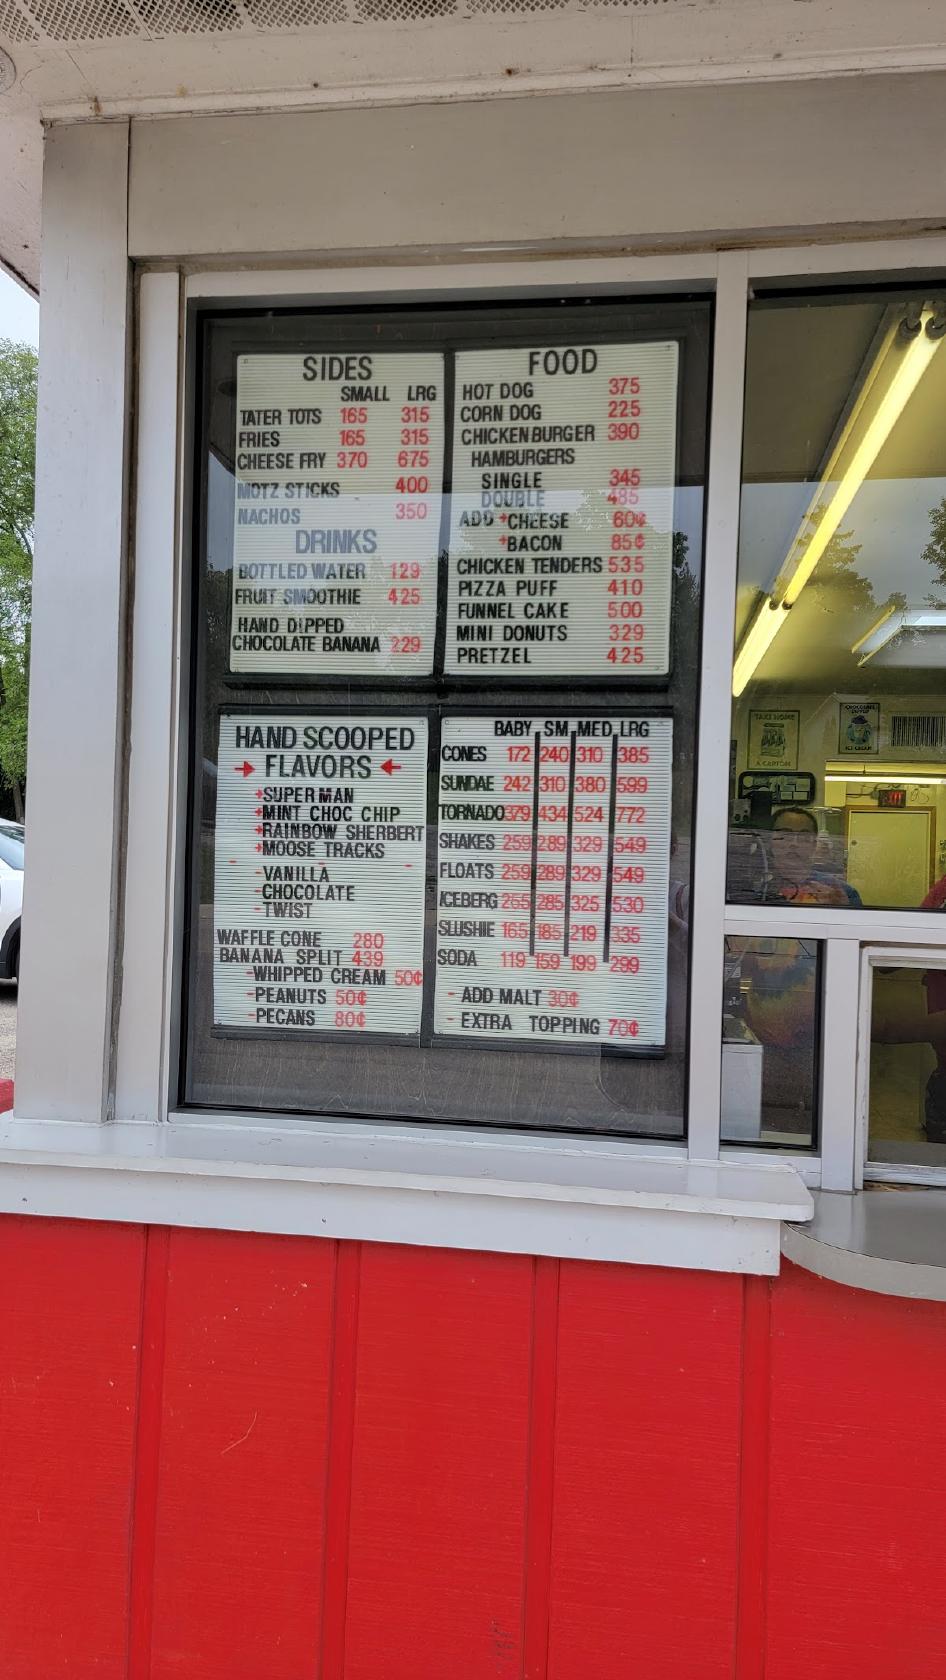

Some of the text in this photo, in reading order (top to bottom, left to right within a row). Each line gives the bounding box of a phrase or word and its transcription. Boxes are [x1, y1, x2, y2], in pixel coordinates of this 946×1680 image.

[302, 356, 373, 381] SIDES
[529, 349, 598, 375] FOOD
[340, 385, 436, 402] SMALL LRG
[463, 378, 640, 400] HOT DOG 375
[240, 407, 429, 426] TATER TOTS 165 315
[461, 400, 641, 422] CORN DOG 225
[239, 429, 429, 448] FRIES 165 315
[608, 423, 640, 440] 390
[237, 451, 429, 470] CHEESE FRY 370 675
[471, 449, 575, 467] HAMBURGERS
[237, 477, 428, 499] MOTZ STICKS 400
[482, 469, 641, 489] SINGLE 345
[481, 488, 639, 507] DOUBLE 485
[238, 503, 427, 524] NACHOS 350
[459, 511, 494, 526] ADD
[508, 513, 569, 529] CHEESE
[295, 530, 377, 554] DRINKS
[507, 535, 562, 552] BACON
[239, 562, 420, 579] BOTTLED WATER 129
[457, 557, 644, 574] CHICKEN TENDERS 535
[235, 588, 420, 605] FRUIT SMOOTHIE 425
[458, 579, 643, 597] PIZZA PUFF 410
[458, 602, 642, 620] FUNNEL CAKE 500
[238, 617, 344, 634] HAND DIPPED
[457, 624, 644, 642] MINI DONUTS 329
[232, 635, 421, 653] CHOCOLATE BANANA 229
[457, 646, 644, 664] PRETZEL 425
[235, 726, 415, 750] HAND SCOOPED
[494, 721, 649, 737] BABY SM MED LRG
[442, 745, 649, 763] CONES 172 240 310 385
[265, 755, 372, 779] FLAVORS
[441, 776, 648, 793] SUNDAE 242 310 380 599
[262, 806, 401, 823] MINT CHOC CHIP
[439, 805, 645, 823] TORNADO 379 434 524 772
[262, 824, 424, 841] RAINBOW SHERBERT
[262, 841, 384, 858] MOOSE TRACKS
[439, 834, 646, 853] SHAKES 259 289 329 549
[263, 866, 330, 882] VANILLA
[440, 863, 644, 883] FLOATS 259 289 329 549
[262, 884, 355, 901] CHOCOLATE
[263, 902, 312, 918] TWIST
[440, 892, 497, 909] ICEBERG
[536, 893, 564, 910] 285
[571, 894, 599, 911] 325
[612, 896, 644, 912] 530
[218, 929, 384, 949] WAFFLE CONE 280
[438, 921, 640, 943] SLUSHIE 165 185 219 335
[219, 948, 384, 967] BANANA SPLIT 439
[438, 950, 640, 973] SODA 119 159 199 299
[253, 967, 323, 983] WHIPPED
[331, 969, 386, 985] CREAM
[255, 988, 326, 1004] PEANUTS
[462, 987, 493, 1003] ADD
[500, 989, 541, 1005] MALT
[256, 1009, 315, 1026] PECANS
[462, 1014, 512, 1030] EXTRA
[530, 1016, 600, 1034] TOPPING
